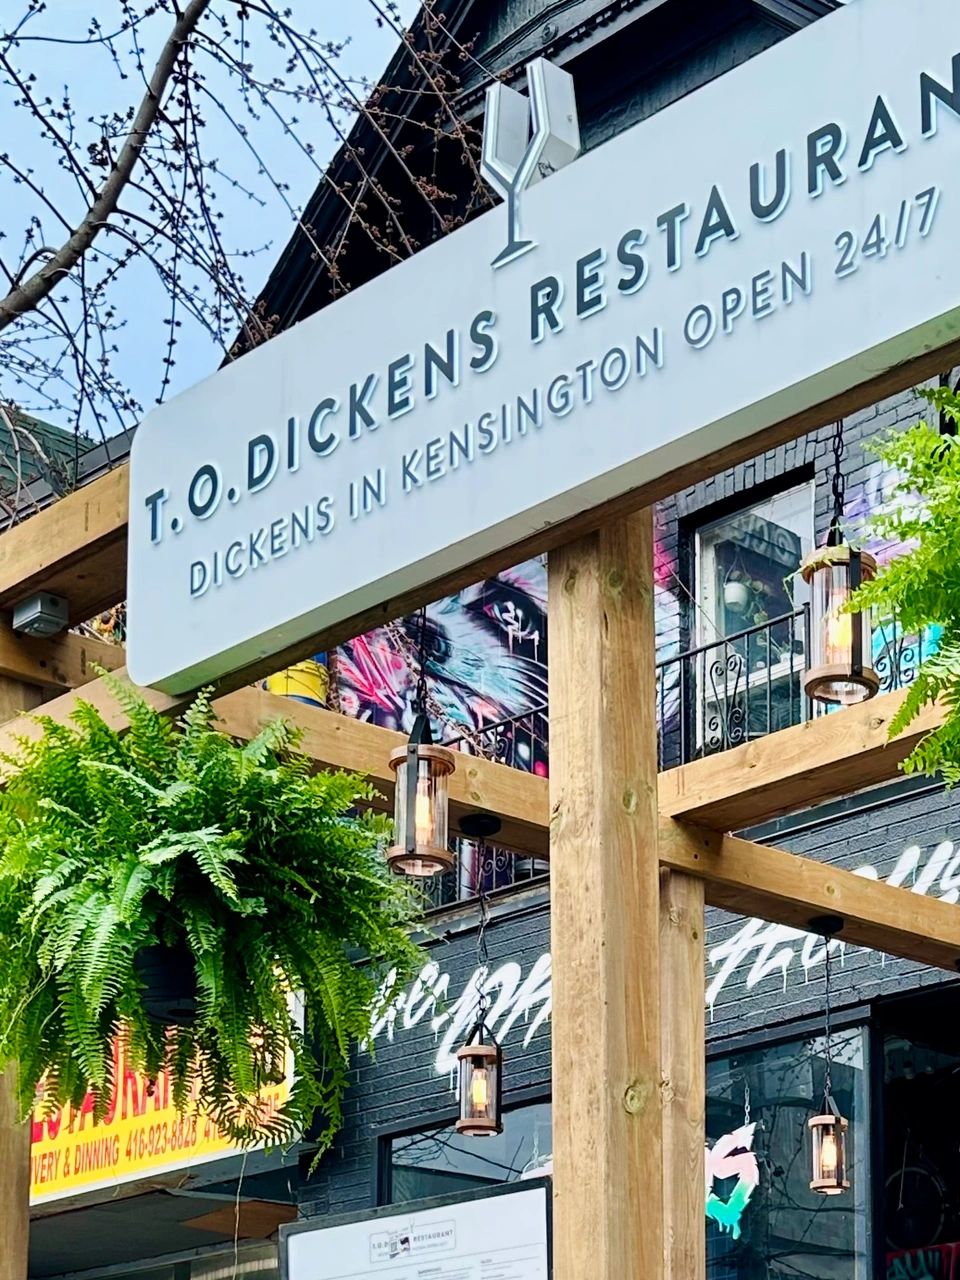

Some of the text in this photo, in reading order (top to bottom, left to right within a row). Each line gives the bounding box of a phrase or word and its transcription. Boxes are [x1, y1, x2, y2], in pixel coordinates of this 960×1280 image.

[189, 185, 941, 597] DICKENS IN KENSINGTON OPEN 24/7
[73, 1134, 120, 1176] DINNING
